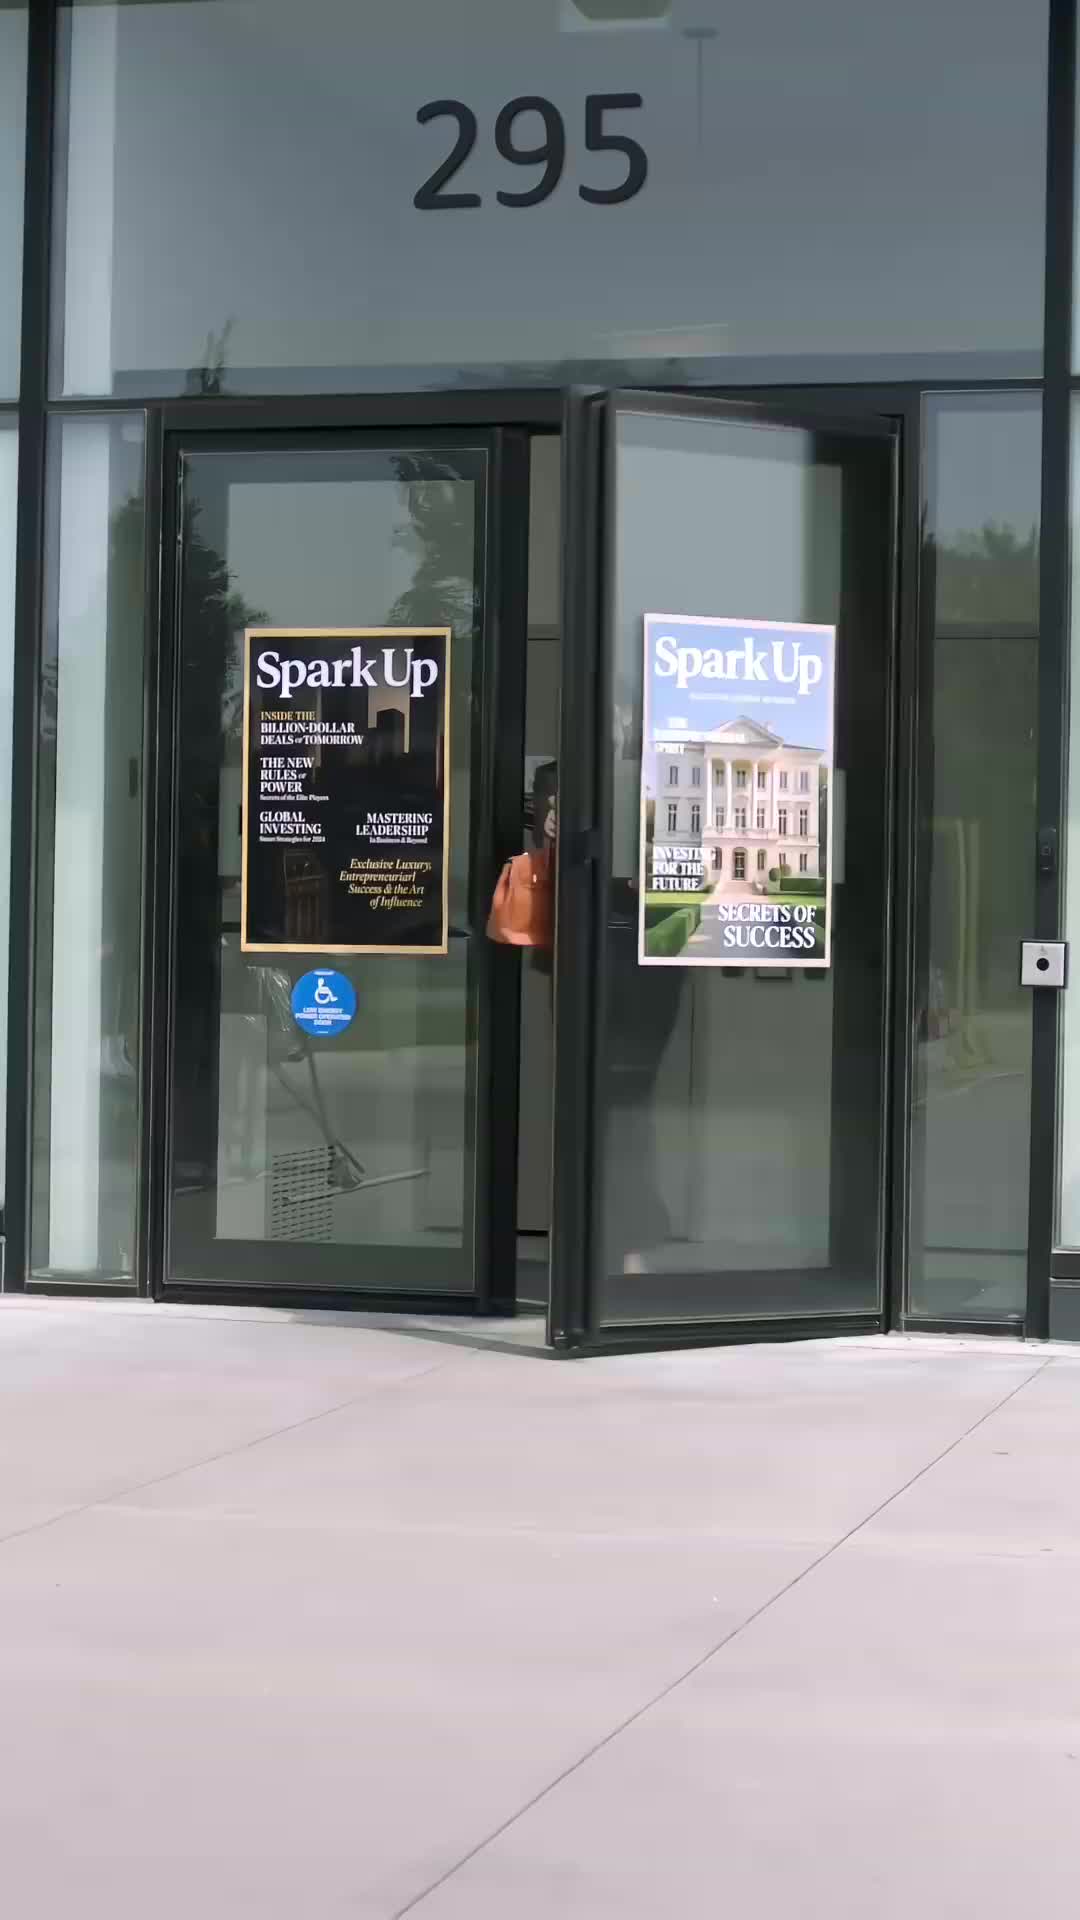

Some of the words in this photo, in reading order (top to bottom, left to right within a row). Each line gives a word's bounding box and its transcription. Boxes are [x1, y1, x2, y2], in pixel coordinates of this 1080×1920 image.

[413, 92, 648, 210] 295
[654, 636, 769, 689] Spark
[771, 641, 822, 695] Up
[256, 646, 377, 698] Spark
[381, 648, 438, 698] Up
[260, 711, 294, 721] INSIDE
[295, 711, 316, 721] THE
[260, 722, 355, 733] BILLION-DOLLAR
[260, 735, 294, 745] DEALS
[303, 735, 364, 745] TOMORROW
[260, 757, 285, 768] THE
[287, 757, 314, 768] NEW
[260, 770, 297, 780] RULES
[260, 782, 303, 793] POWER
[260, 811, 306, 822] GLOBAL
[367, 813, 433, 824] MASTERING
[260, 823, 322, 834] INVESTING
[356, 825, 429, 836] LEADERSHIP
[653, 847, 716, 861] INVESTING
[350, 858, 393, 869] Exclusive
[653, 862, 678, 876] FOR
[680, 862, 704, 876] THE
[348, 884, 381, 895] Success
[384, 884, 392, 894] &
[394, 884, 408, 895] the
[409, 884, 424, 895] Art
[653, 877, 700, 891] FUTURE
[370, 897, 380, 910] of
[380, 897, 423, 910] Influence
[718, 904, 792, 922] SECRETS
[793, 905, 817, 923] OF
[724, 926, 816, 949] SUCCESS
